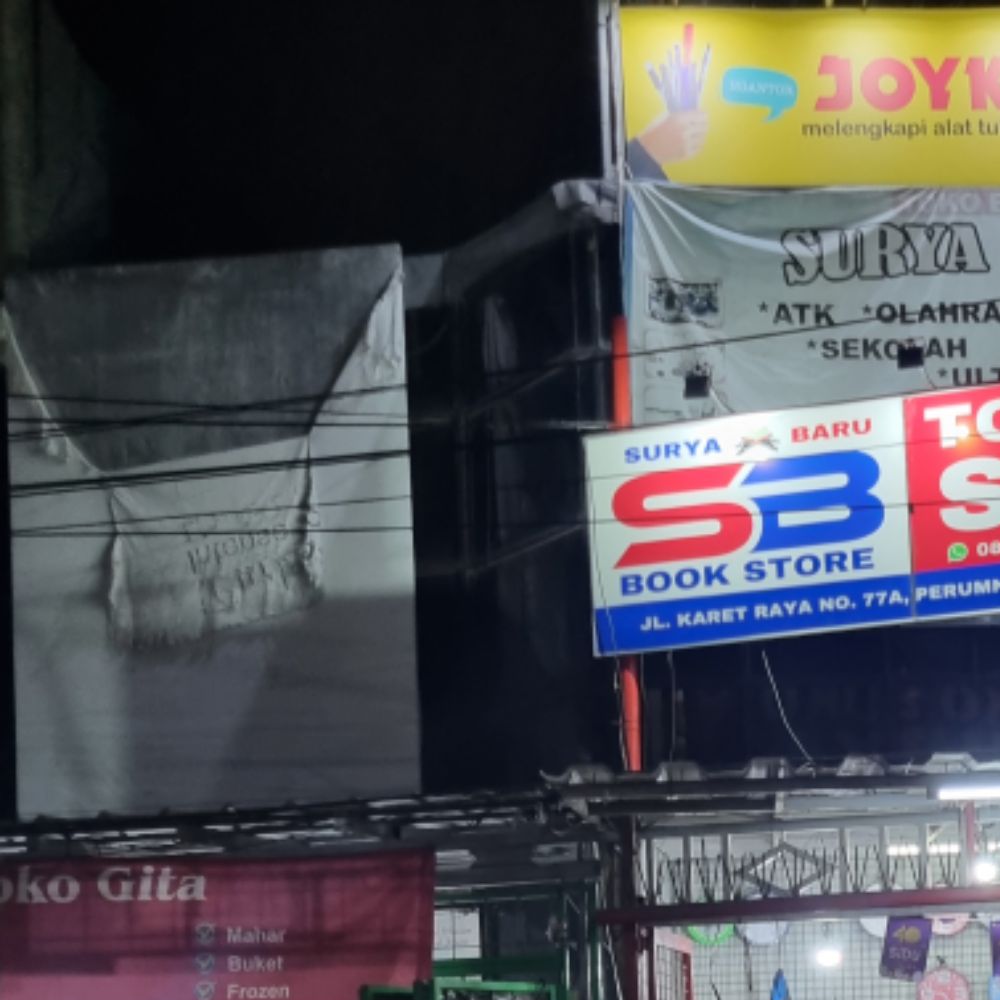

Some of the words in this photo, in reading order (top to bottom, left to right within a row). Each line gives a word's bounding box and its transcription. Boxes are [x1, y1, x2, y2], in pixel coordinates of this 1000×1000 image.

[802, 119, 927, 141] melengkapi
[933, 119, 972, 136] alat
[782, 223, 990, 286] SURYA
[807, 337, 967, 360] SEKOAH
[625, 438, 720, 463] SURYA
[791, 418, 872, 443] BARU
[612, 450, 884, 569] SB
[620, 564, 729, 596] BOOK
[743, 547, 875, 583] STORE
[641, 615, 670, 631] JL.
[677, 606, 747, 627] KARET
[754, 602, 812, 618] RAYA
[819, 597, 856, 612] NO.
[863, 591, 910, 607] 77A,
[97, 865, 206, 902] Gita
[227, 926, 286, 943] Mahar
[227, 955, 284, 972] Buket
[227, 984, 290, 1000] Frozen
